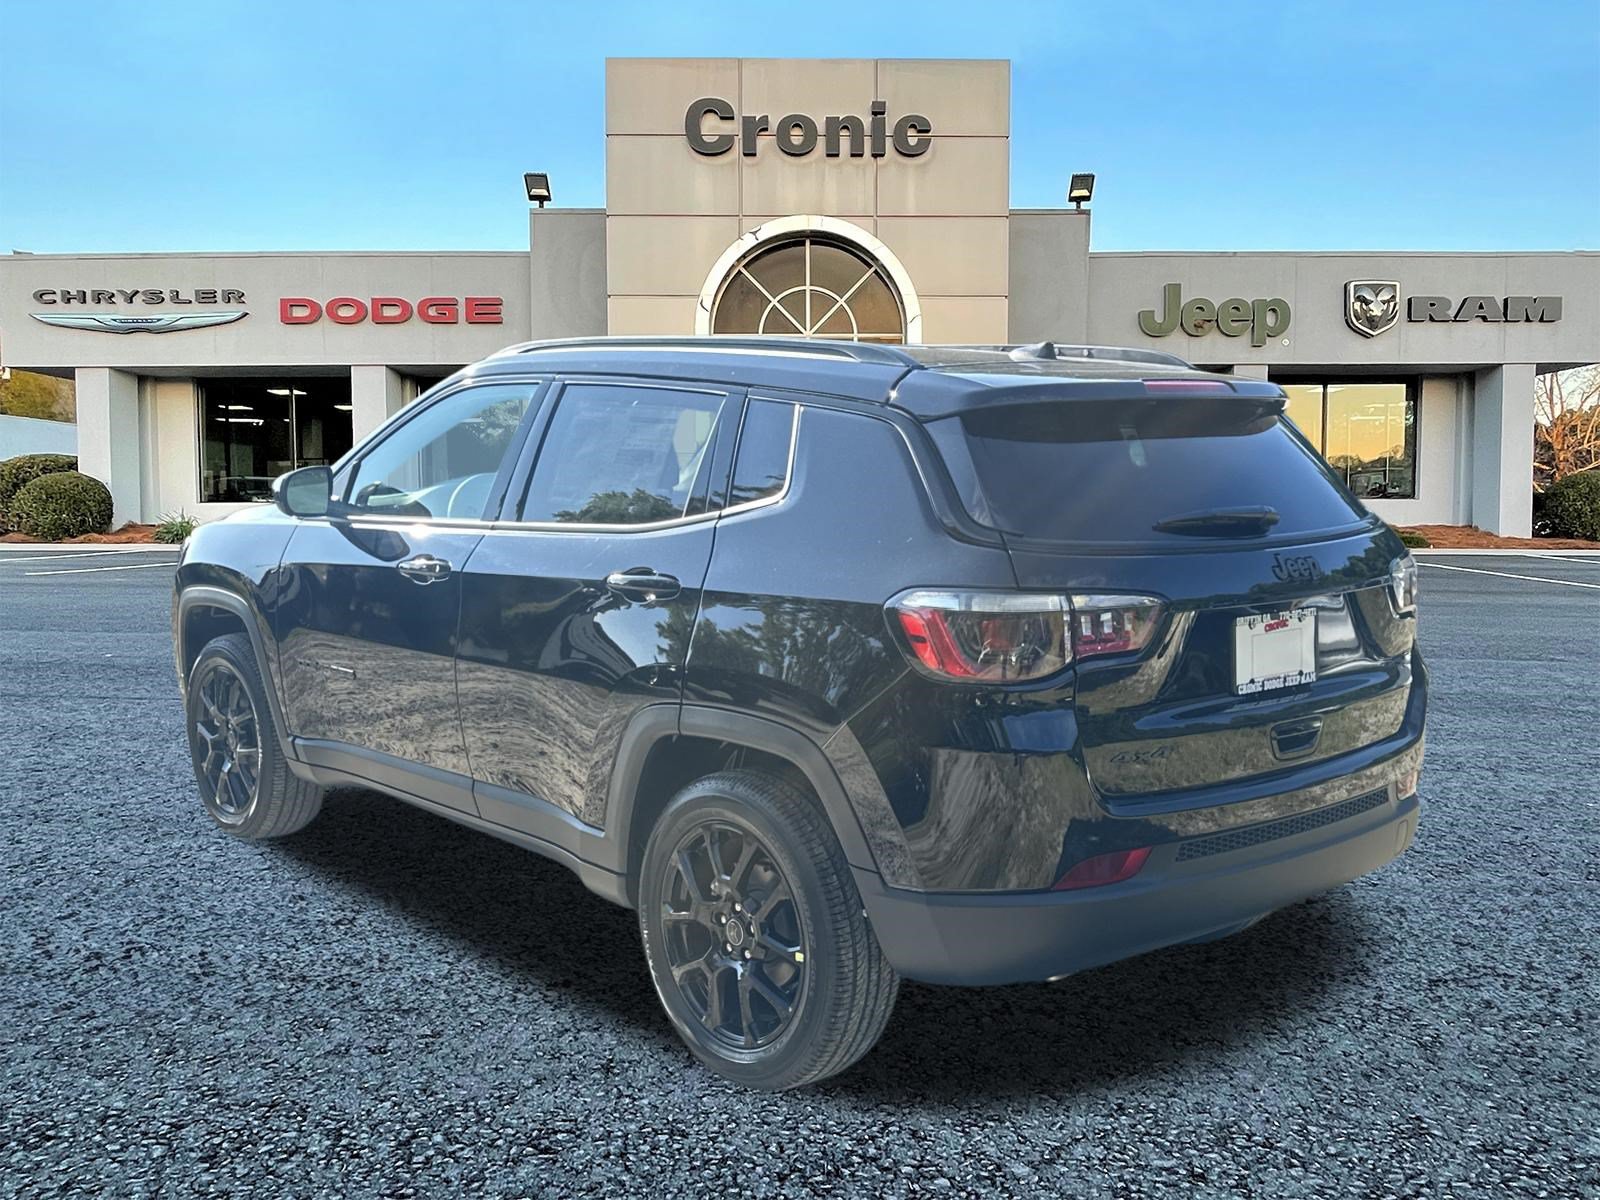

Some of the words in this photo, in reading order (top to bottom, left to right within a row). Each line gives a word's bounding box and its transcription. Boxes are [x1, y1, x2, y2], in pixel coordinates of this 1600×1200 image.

[685, 97, 932, 158] Cronic
[32, 288, 247, 305] CHRYSLER
[1407, 296, 1563, 322] RAM
[280, 297, 503, 324] DODGE
[1138, 283, 1292, 347] Jeep
[1271, 553, 1320, 581] Jeep
[1264, 678, 1284, 691] DODGE
[1285, 675, 1300, 687] JEEP
